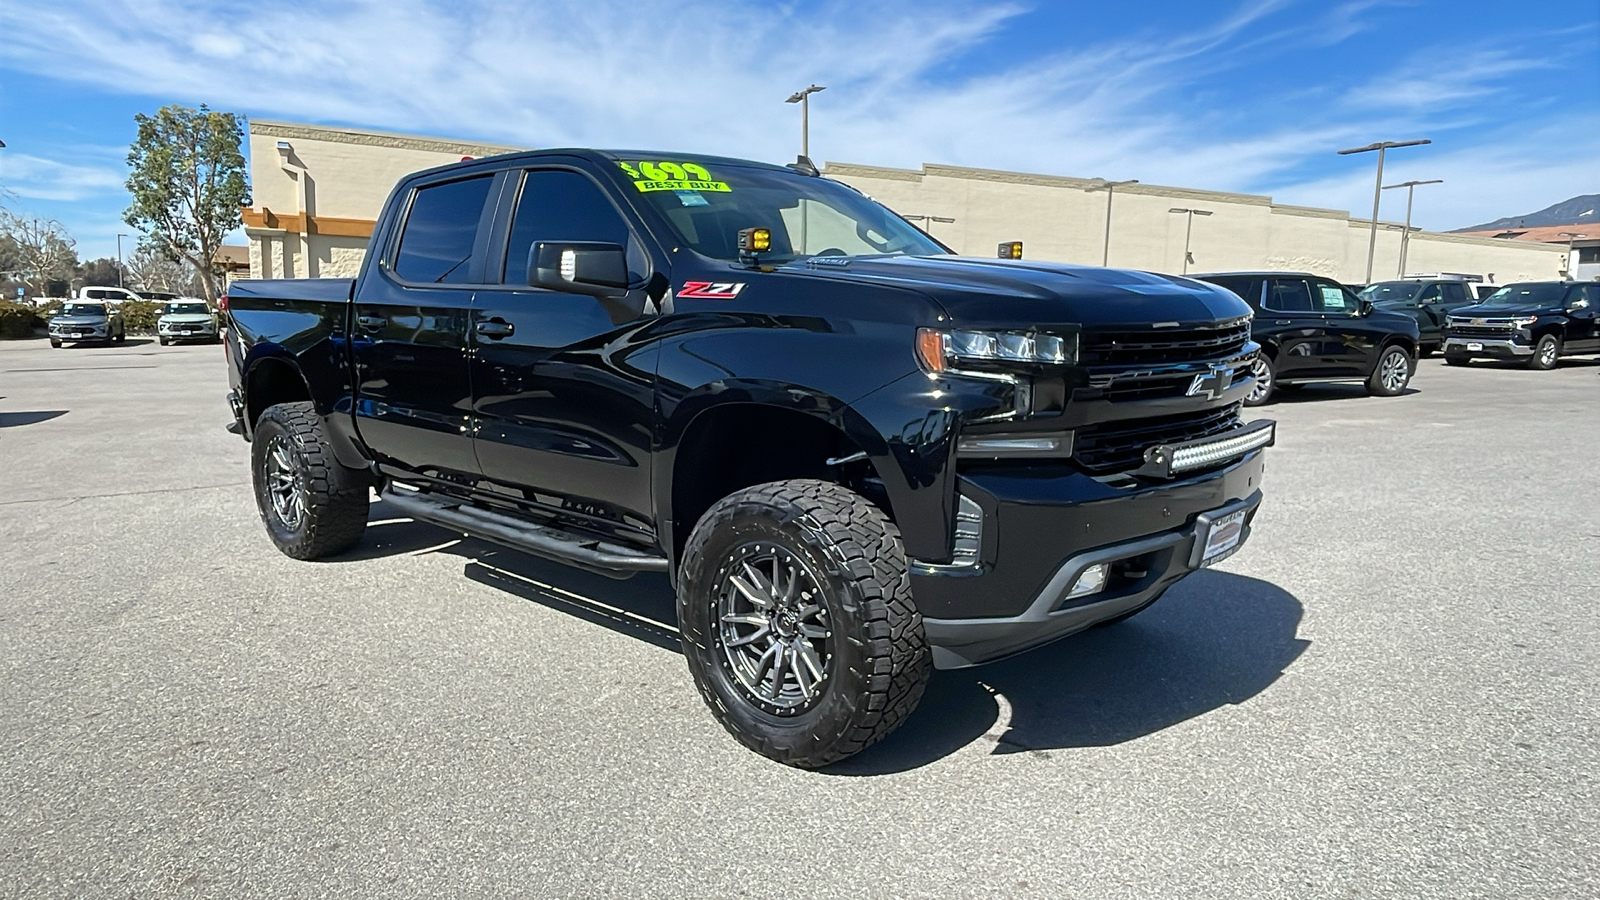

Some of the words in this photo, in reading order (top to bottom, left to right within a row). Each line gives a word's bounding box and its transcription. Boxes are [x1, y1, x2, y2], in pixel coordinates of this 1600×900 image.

[644, 181, 683, 189] BEST
[691, 182, 722, 190] BUY
[676, 281, 746, 299] Z71
